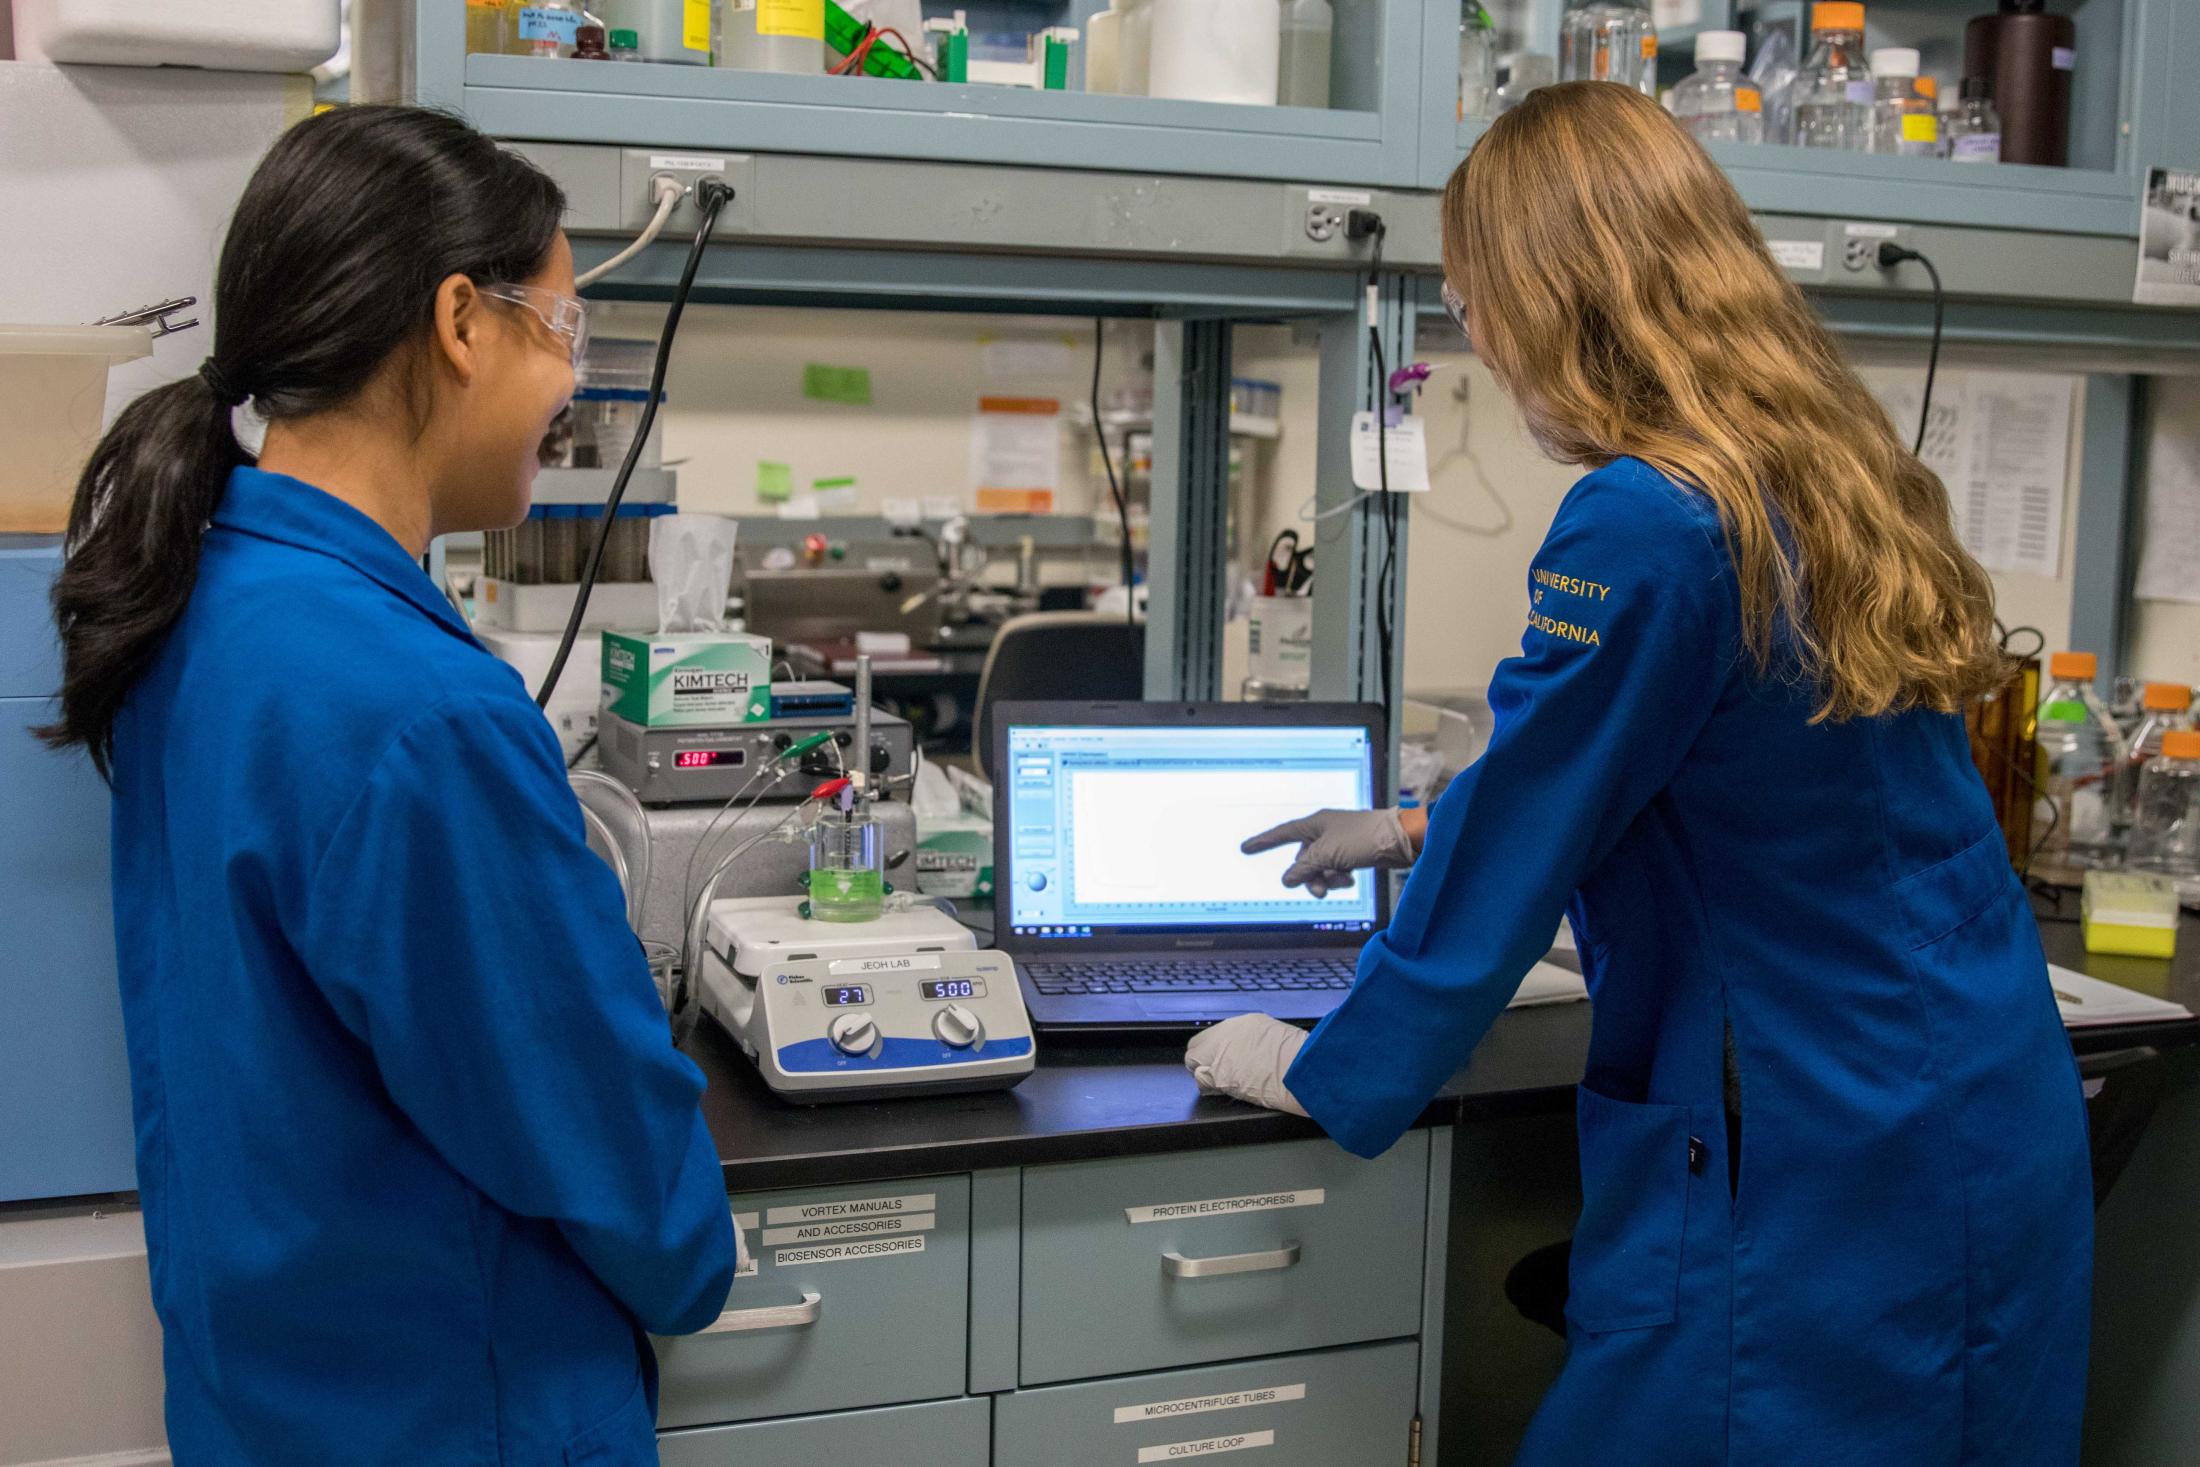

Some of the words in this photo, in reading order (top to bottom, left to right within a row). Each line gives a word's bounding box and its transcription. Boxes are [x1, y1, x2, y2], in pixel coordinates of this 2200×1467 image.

[1531, 568, 1611, 601] UNIVERSITY
[1533, 588, 1544, 605] OF
[673, 672, 748, 689] KIMTECH
[860, 960, 890, 971] JEOH
[890, 958, 911, 969] LAB
[839, 988, 862, 1004] 27
[935, 982, 970, 998] 500
[801, 1205, 847, 1218] VORTEX
[849, 1199, 902, 1213] MANUALS
[1152, 1204, 1197, 1217] PROTEIN
[1199, 1194, 1296, 1213] ELECTROPHORESIS
[797, 1227, 821, 1239] AND
[823, 1219, 902, 1236] ACCESSORIES
[777, 1248, 842, 1263] BIOSENSOR
[844, 1239, 922, 1256] ACCESSORIES
[1145, 1395, 1240, 1416] MICROCENTRIFUGE
[1243, 1390, 1276, 1403] TUBES
[1168, 1441, 1215, 1456] CULTURE
[1217, 1437, 1245, 1450] LOOP
